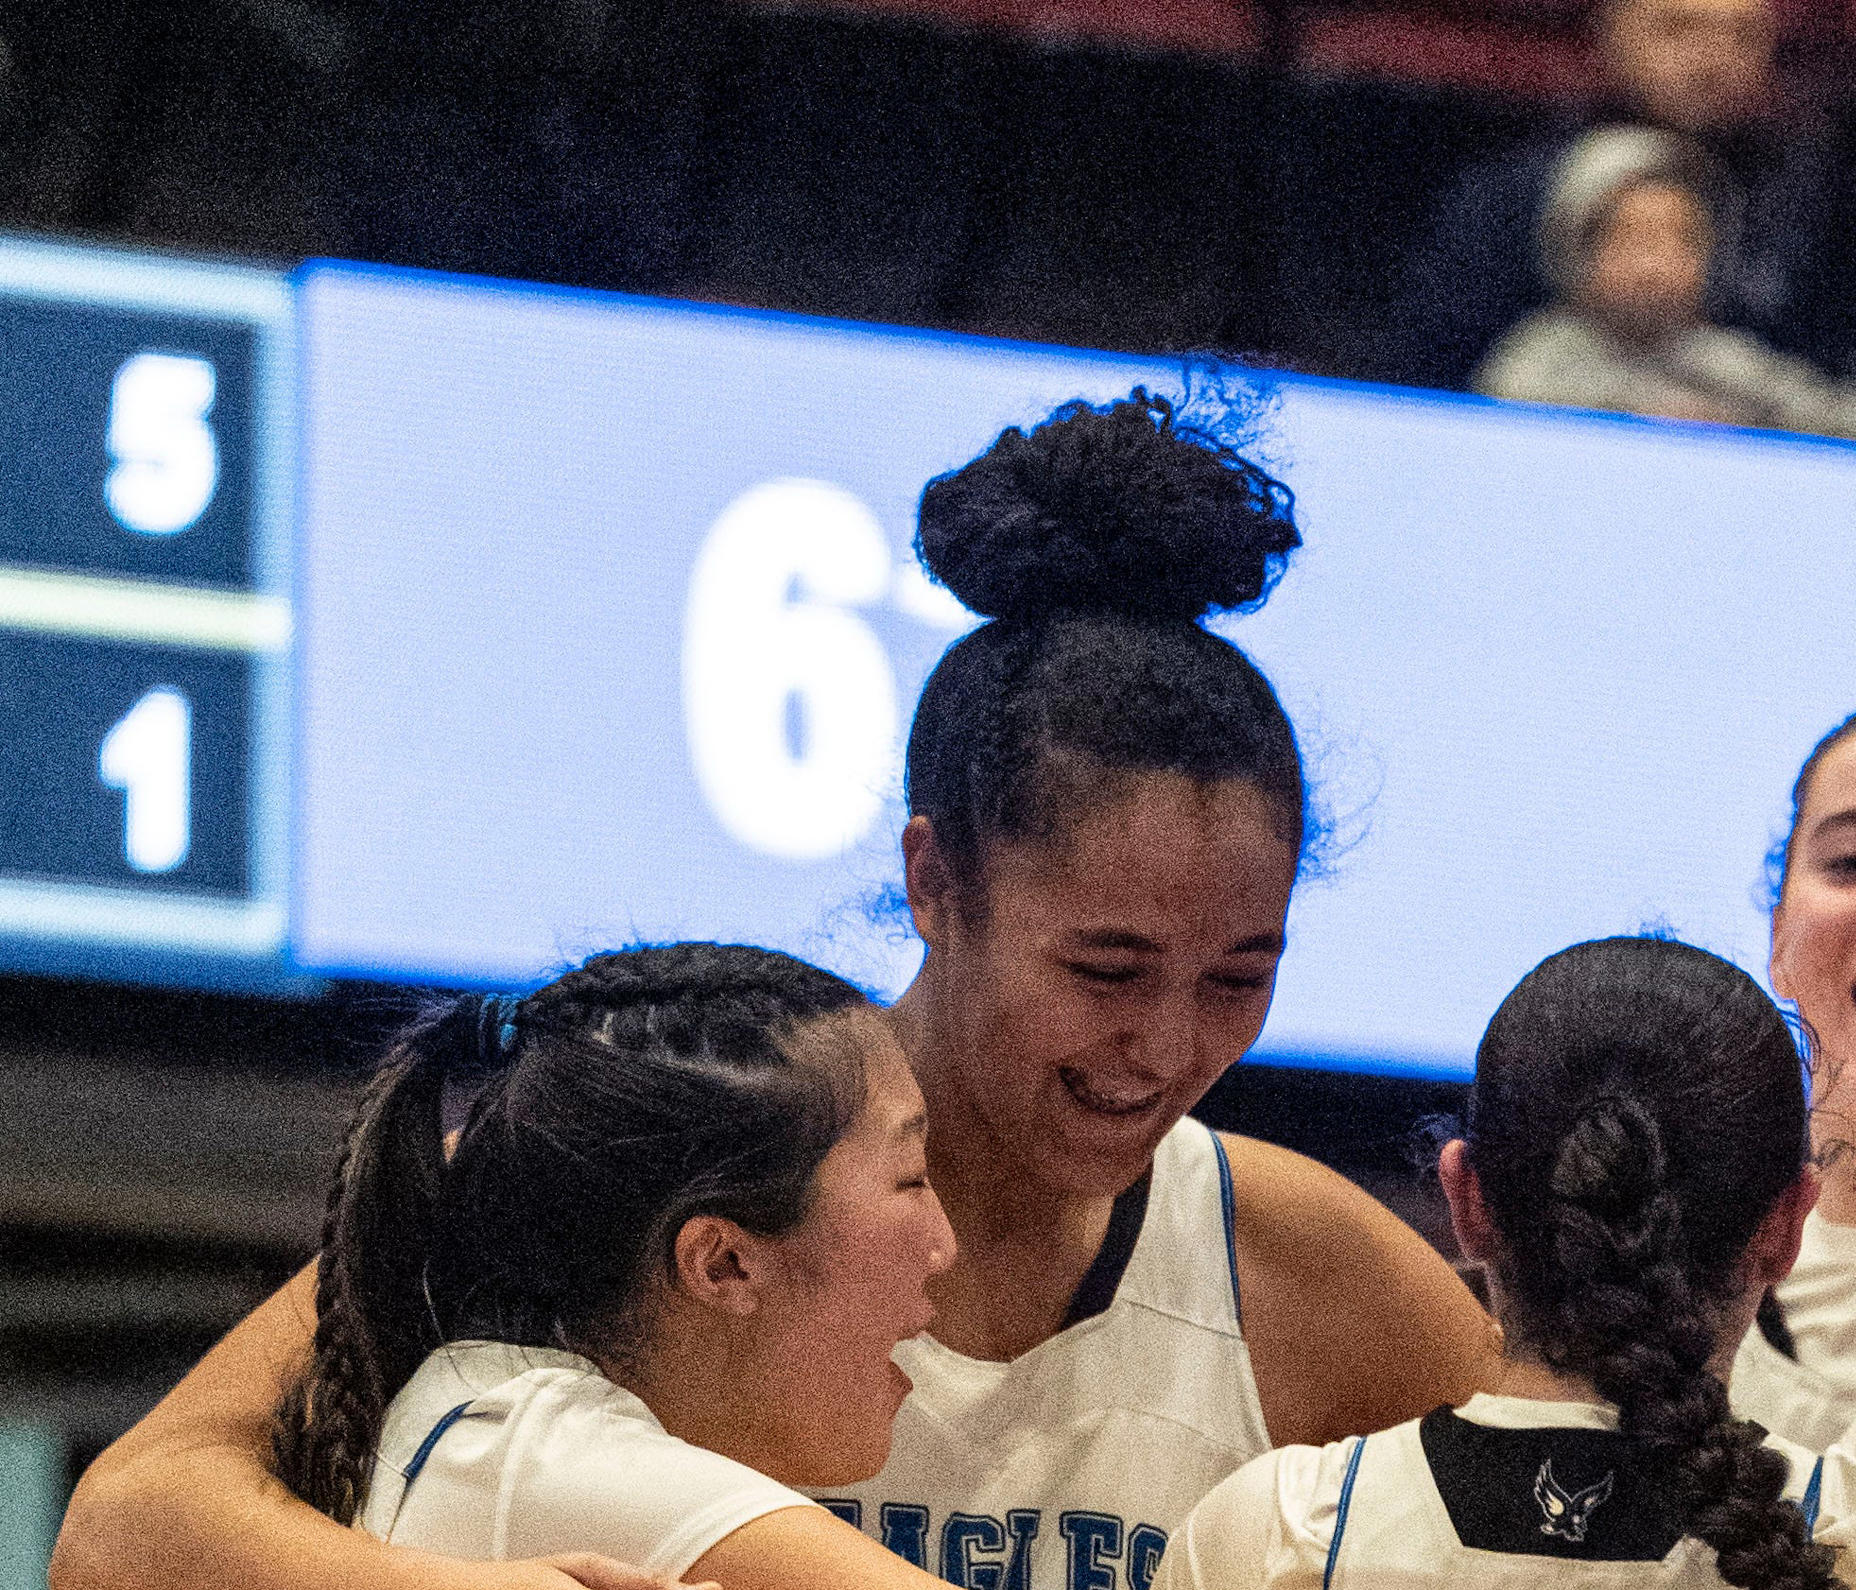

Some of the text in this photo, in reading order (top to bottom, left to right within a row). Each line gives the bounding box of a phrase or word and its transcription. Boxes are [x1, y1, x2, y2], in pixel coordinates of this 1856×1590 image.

[104, 351, 218, 535] 5
[683, 476, 1000, 860] 6
[100, 685, 192, 873] 1
